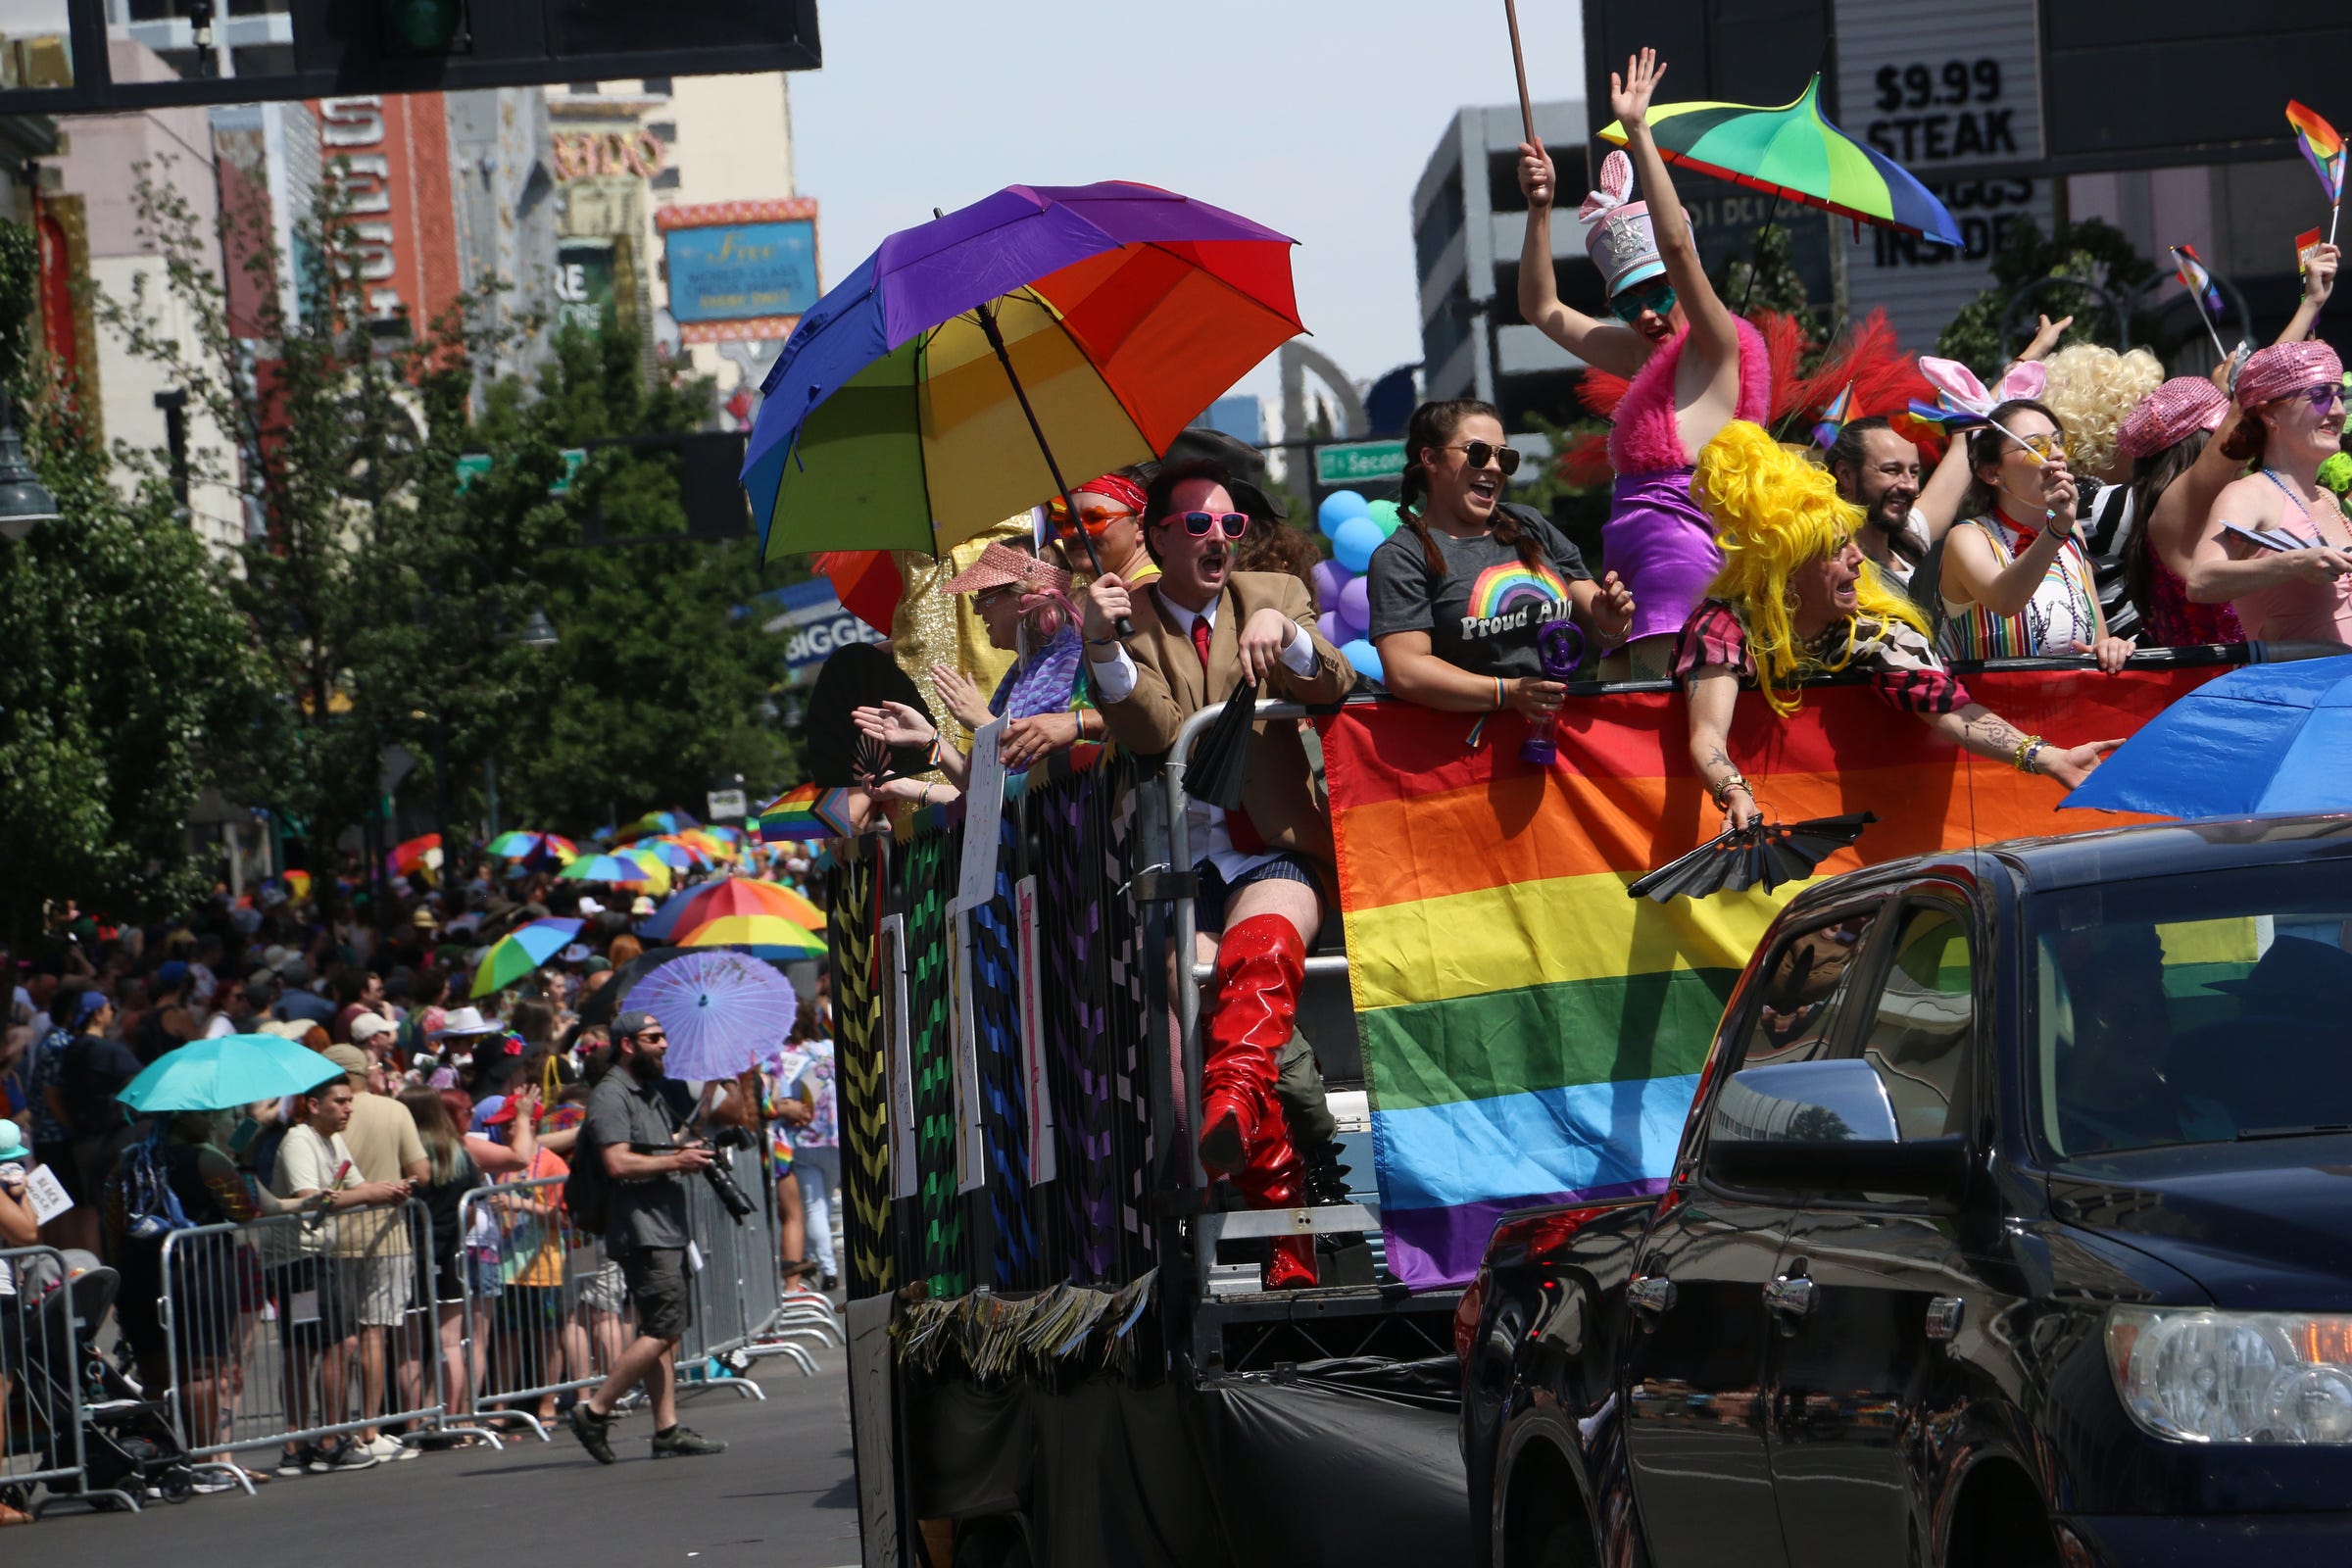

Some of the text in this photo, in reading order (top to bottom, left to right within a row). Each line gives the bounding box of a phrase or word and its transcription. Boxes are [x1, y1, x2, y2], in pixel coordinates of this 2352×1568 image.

[1875, 58, 2001, 114] $9.99
[1867, 108, 2018, 162] STEAK
[1931, 176, 2034, 210] GGS
[1874, 212, 2021, 268] INDE
[784, 616, 887, 662] BIGGE
[1460, 605, 1529, 641] Proud
